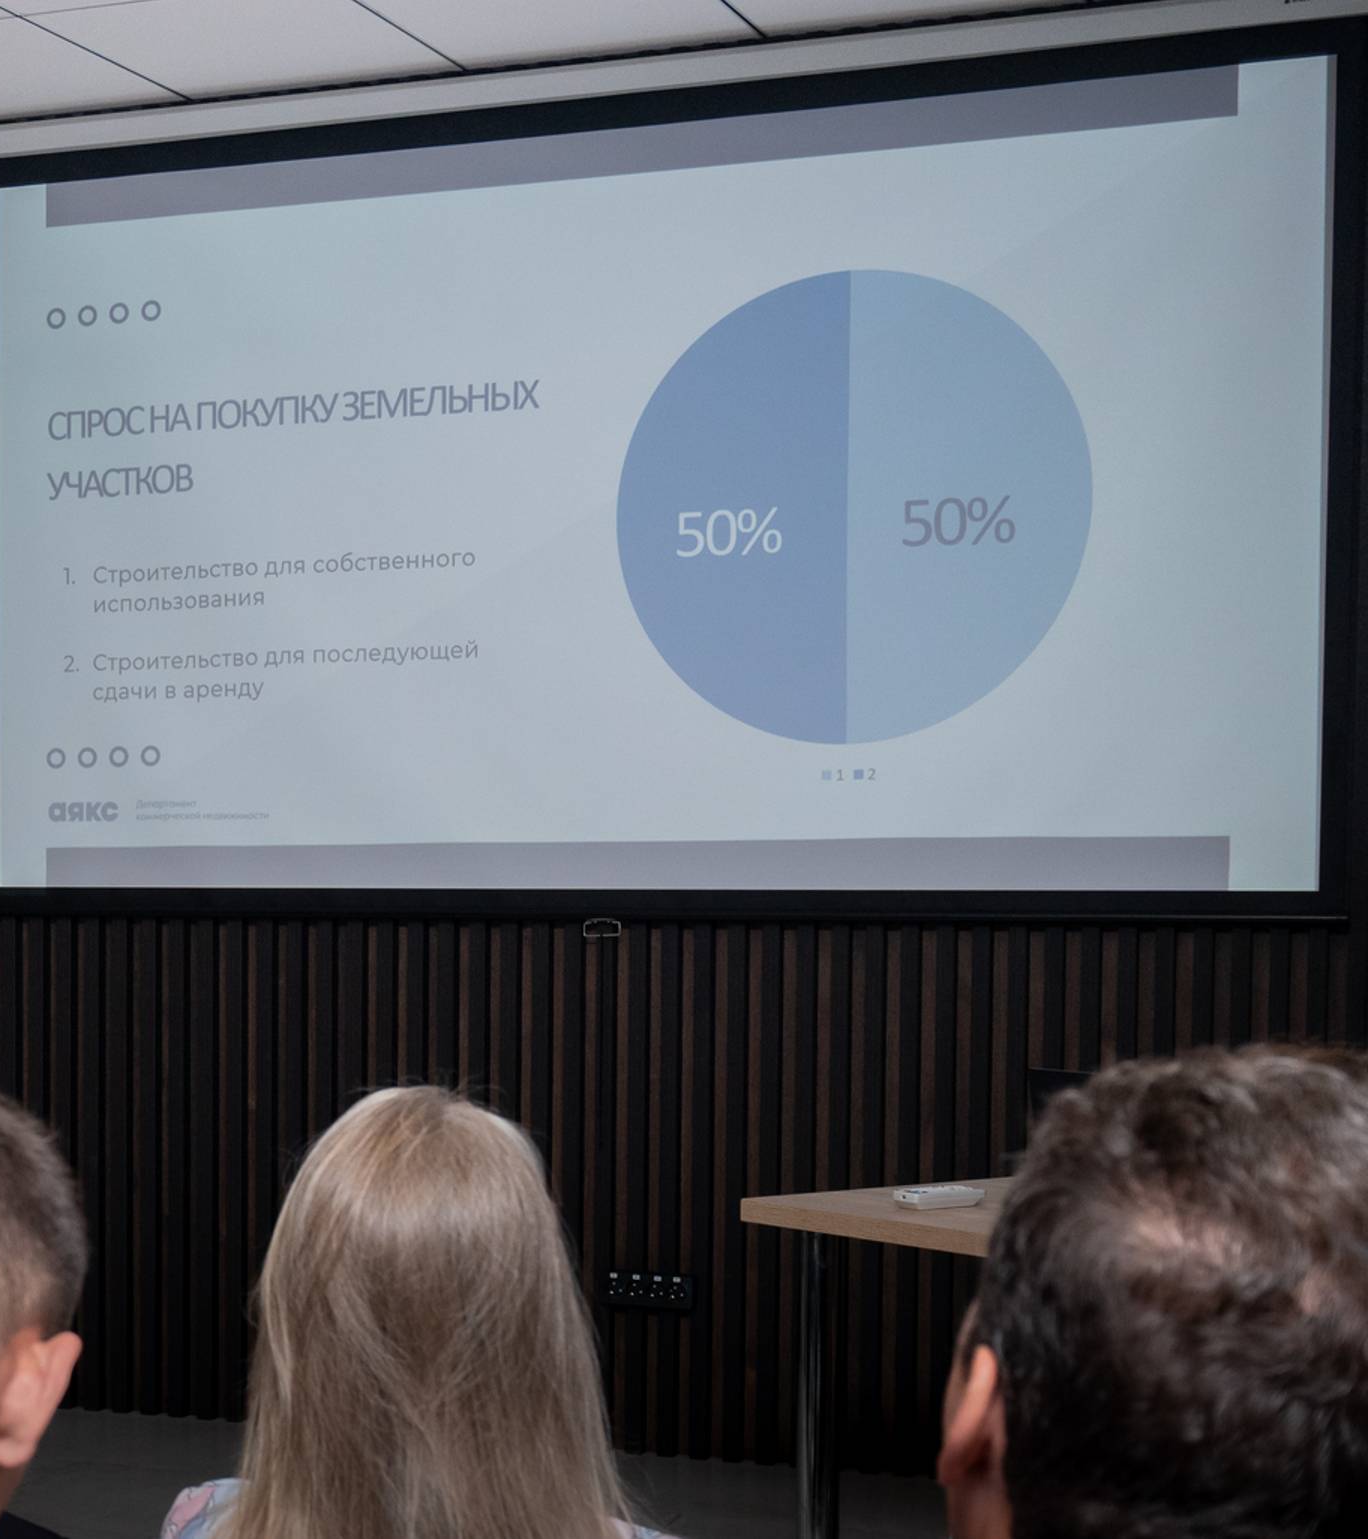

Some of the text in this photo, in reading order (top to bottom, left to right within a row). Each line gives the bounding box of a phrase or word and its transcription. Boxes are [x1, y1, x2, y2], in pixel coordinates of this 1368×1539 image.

[48, 379, 540, 440] СПРОС НА ПОКУПКУ ЗЕМЕЛЬНЫХ
[47, 463, 194, 500] УЧАСТКОВ
[675, 506, 783, 557] 50%
[901, 495, 1016, 547] 50%
[63, 551, 477, 587] 1. Строительство для собственного
[93, 589, 266, 613] использования
[63, 640, 479, 675] 2. Строительство для последующей
[92, 679, 265, 703] сдачи в аренду
[867, 767, 877, 781] 2
[48, 800, 120, 823] аякс
